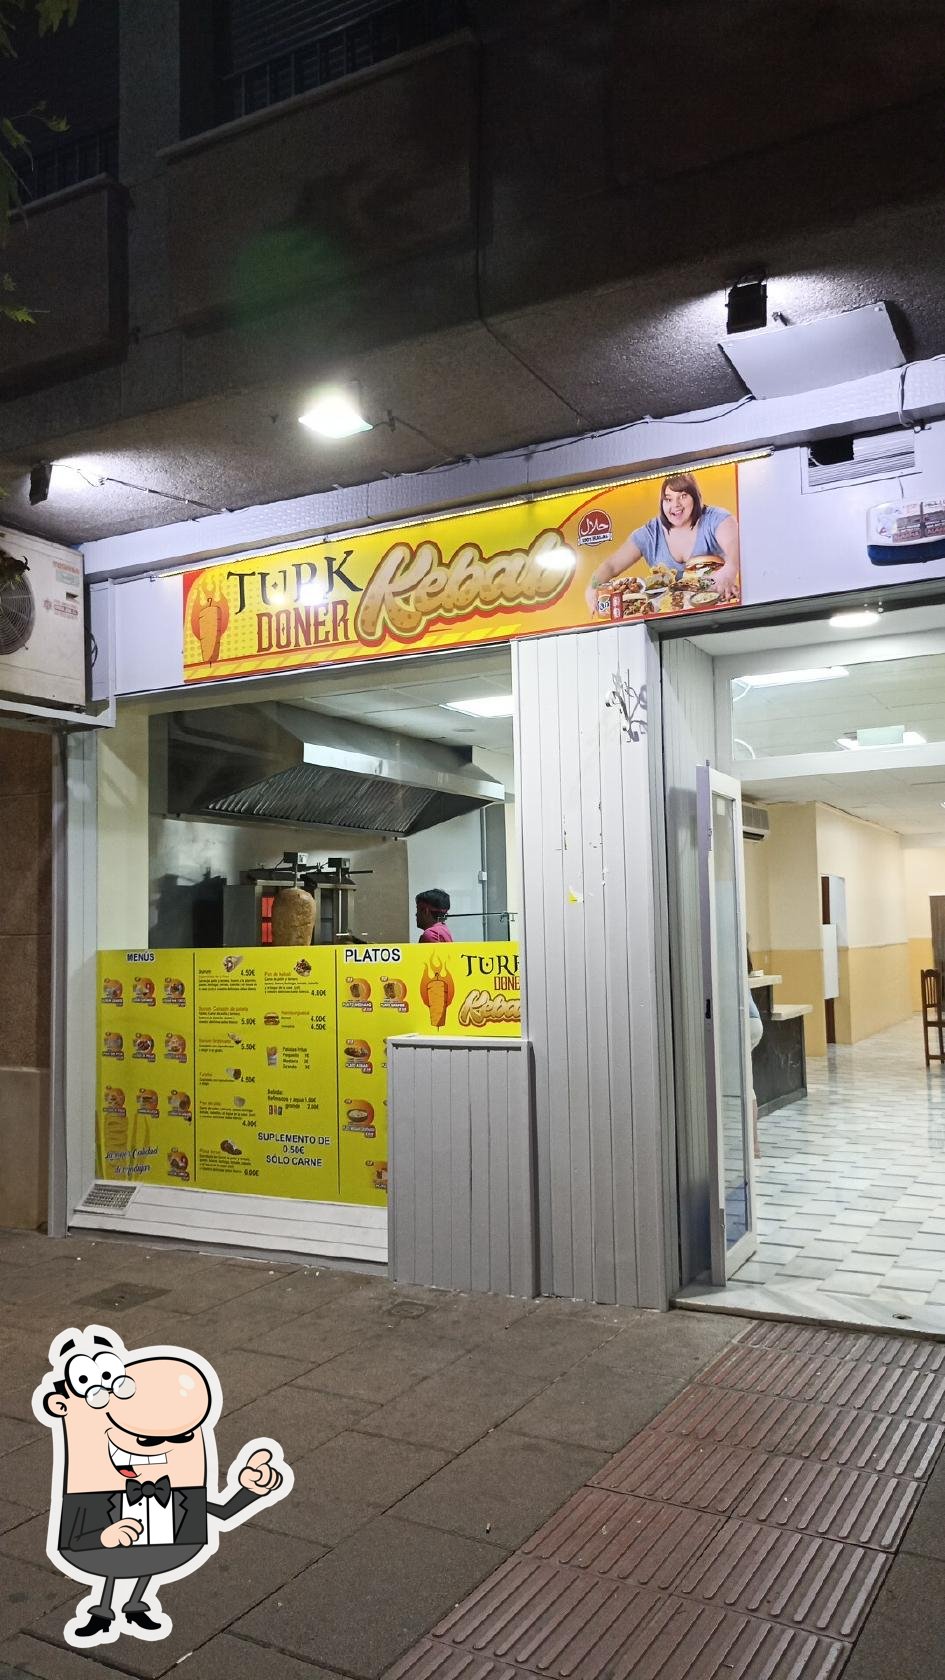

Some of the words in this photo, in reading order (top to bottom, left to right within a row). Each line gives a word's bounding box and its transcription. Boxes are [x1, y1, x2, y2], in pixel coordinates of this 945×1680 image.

[581, 518, 609, 535] حلال
[355, 529, 576, 645] Kebab
[256, 600, 350, 653] DONER
[127, 951, 155, 962] MENÚS
[345, 948, 401, 962] PLATOS
[258, 1132, 316, 1144] SUPLEMENTO
[318, 1136, 330, 1145] DE
[292, 1157, 322, 1166] CARNE
